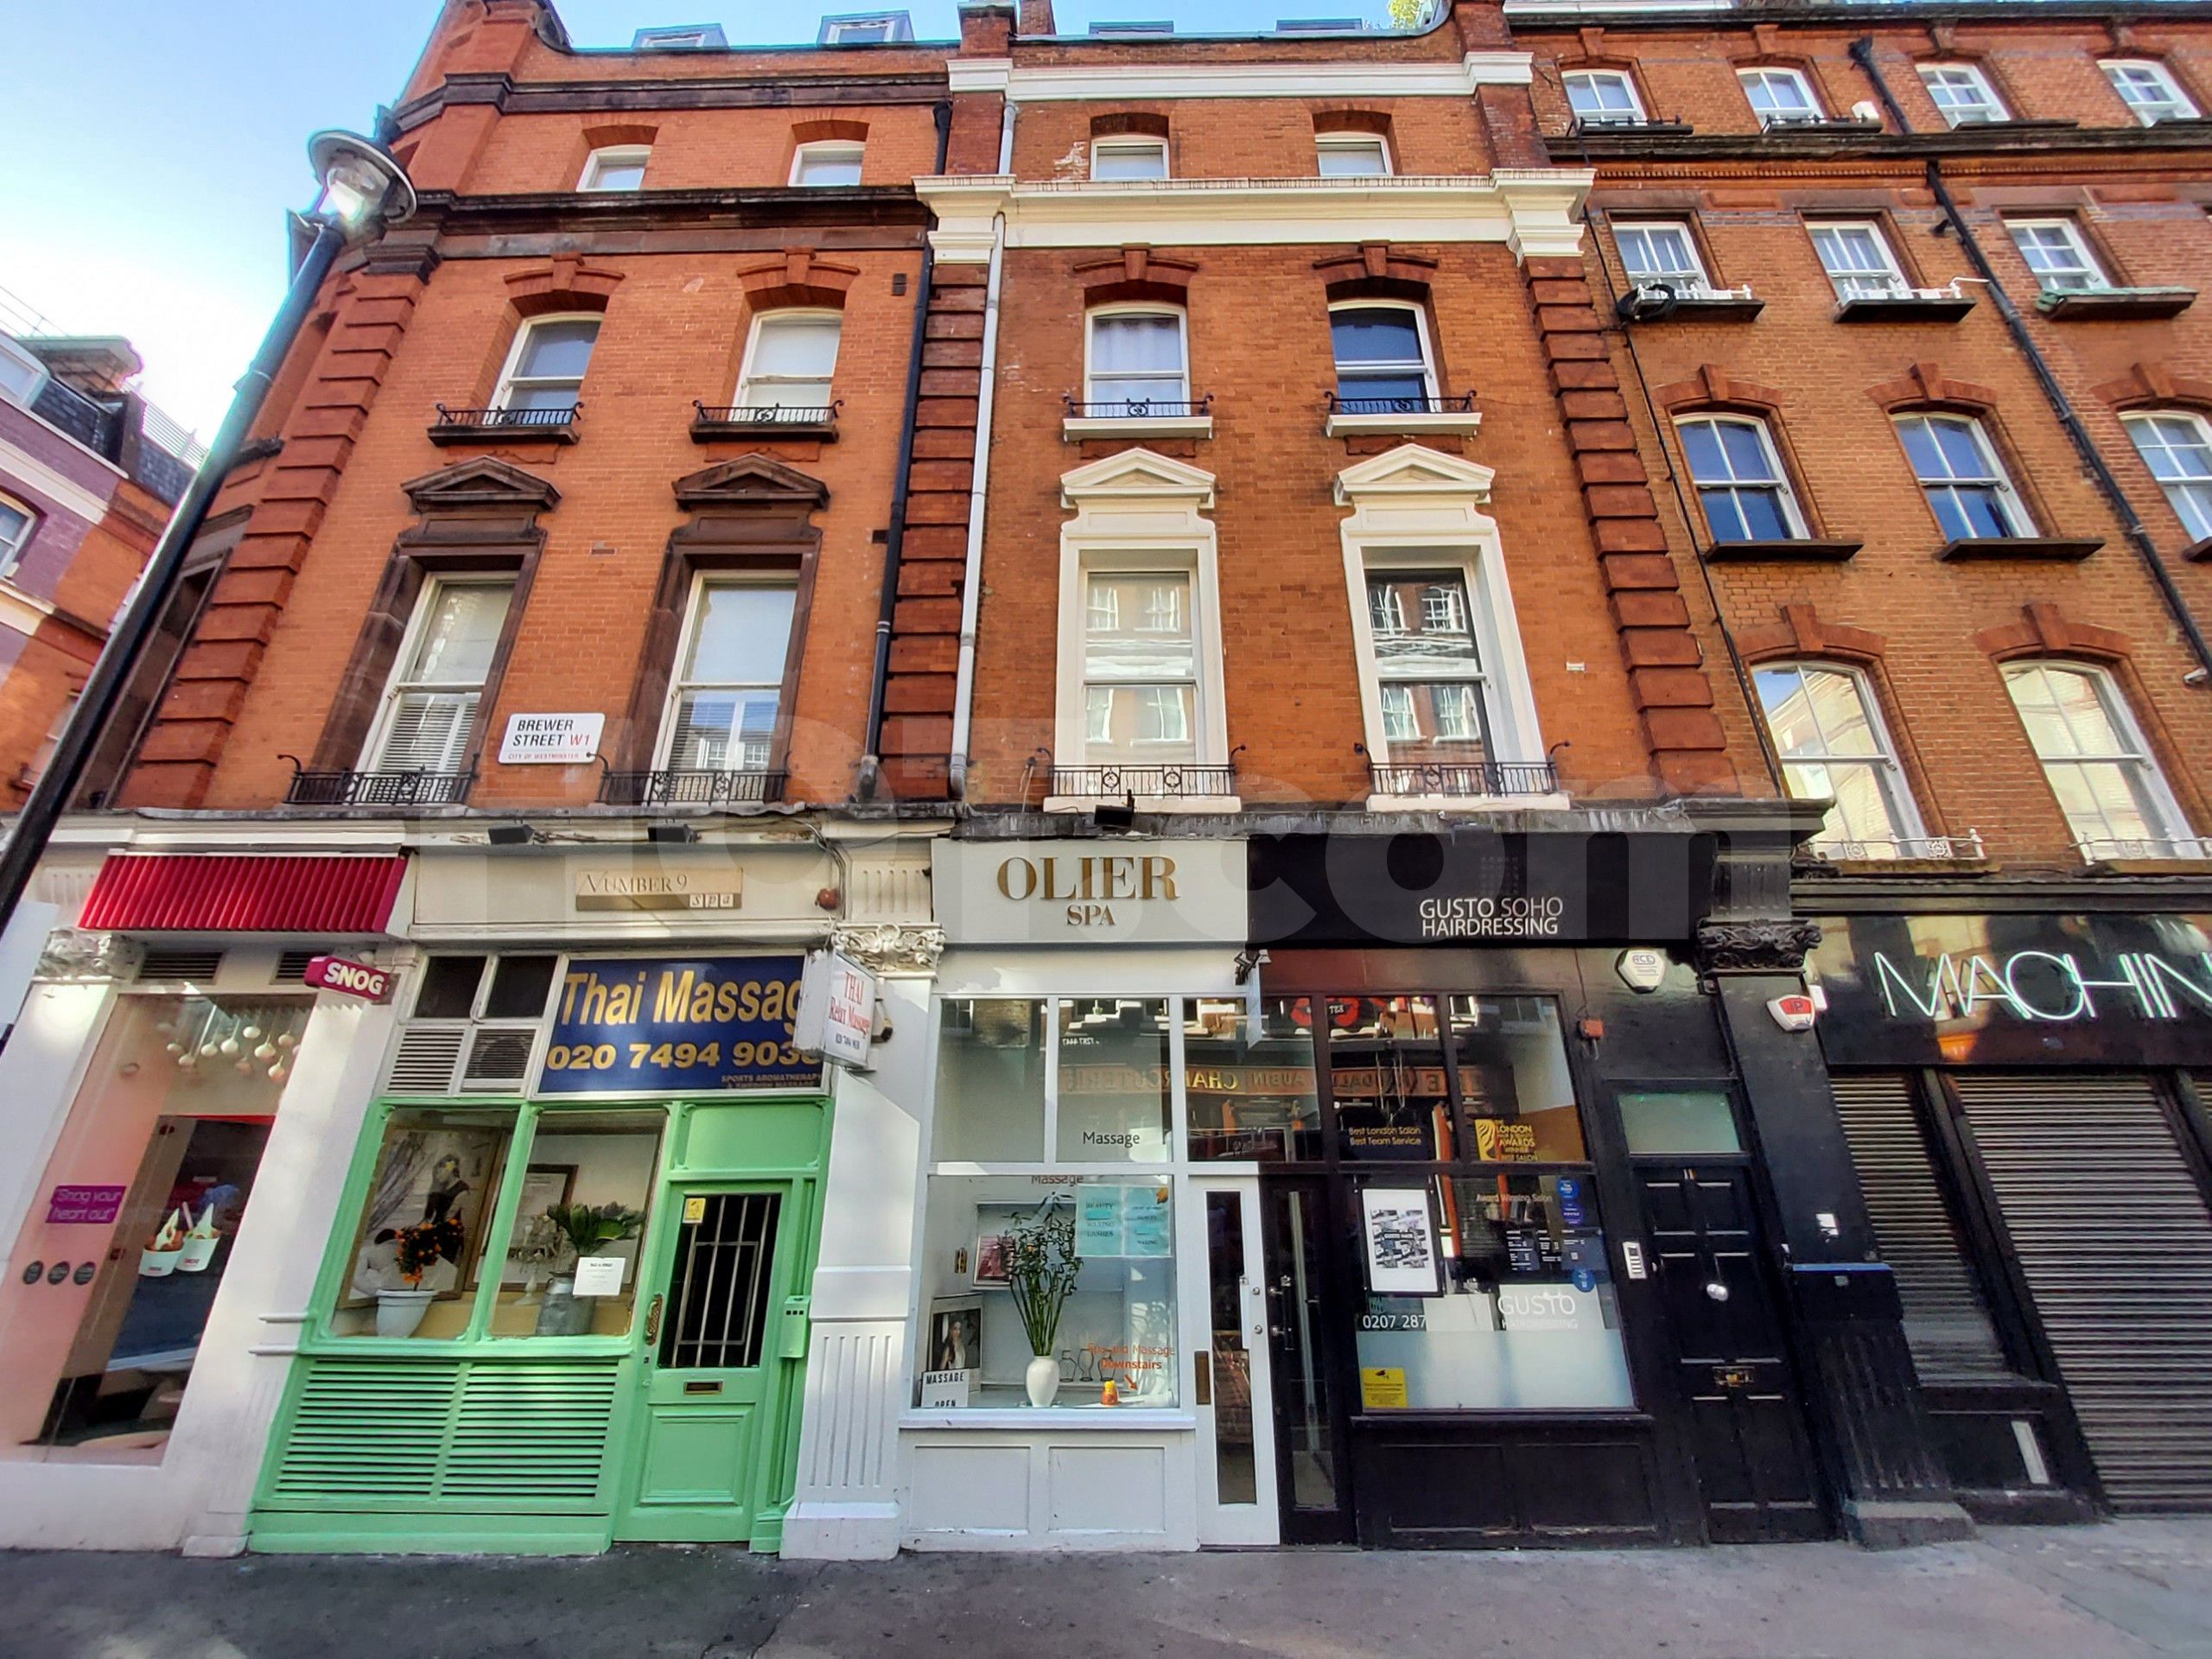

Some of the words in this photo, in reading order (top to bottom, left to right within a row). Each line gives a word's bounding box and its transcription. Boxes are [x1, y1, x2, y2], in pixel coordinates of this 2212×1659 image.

[517, 719, 574, 732] BREWER
[512, 734, 565, 747] STREET
[569, 734, 590, 747] W1
[578, 870, 672, 896] NUMBER
[677, 873, 688, 892] 9
[996, 855, 1181, 901] OLIER
[690, 894, 734, 909] spa
[1419, 898, 1495, 918] GUSTO
[1501, 896, 1564, 918] SOHO
[1066, 905, 1116, 926] SPA
[1422, 918, 1559, 937] HAIRDRESSING
[324, 962, 385, 996] SNOG
[844, 970, 864, 1006] THAI
[562, 971, 646, 1027] Thai
[653, 969, 802, 1036] Massag
[546, 1044, 617, 1071] 020
[628, 1041, 721, 1069] 7494
[1497, 1125, 1532, 1134] LONDON
[1083, 1131, 1141, 1148] Massage
[1497, 1294, 1576, 1314] GUSTO
[1363, 1314, 1396, 1329] 0207
[1402, 1314, 1426, 1329] 287
[1133, 1344, 1175, 1357] Massage
[1102, 1358, 1162, 1370] Downstairs
[926, 1372, 964, 1384] MASSAGE
